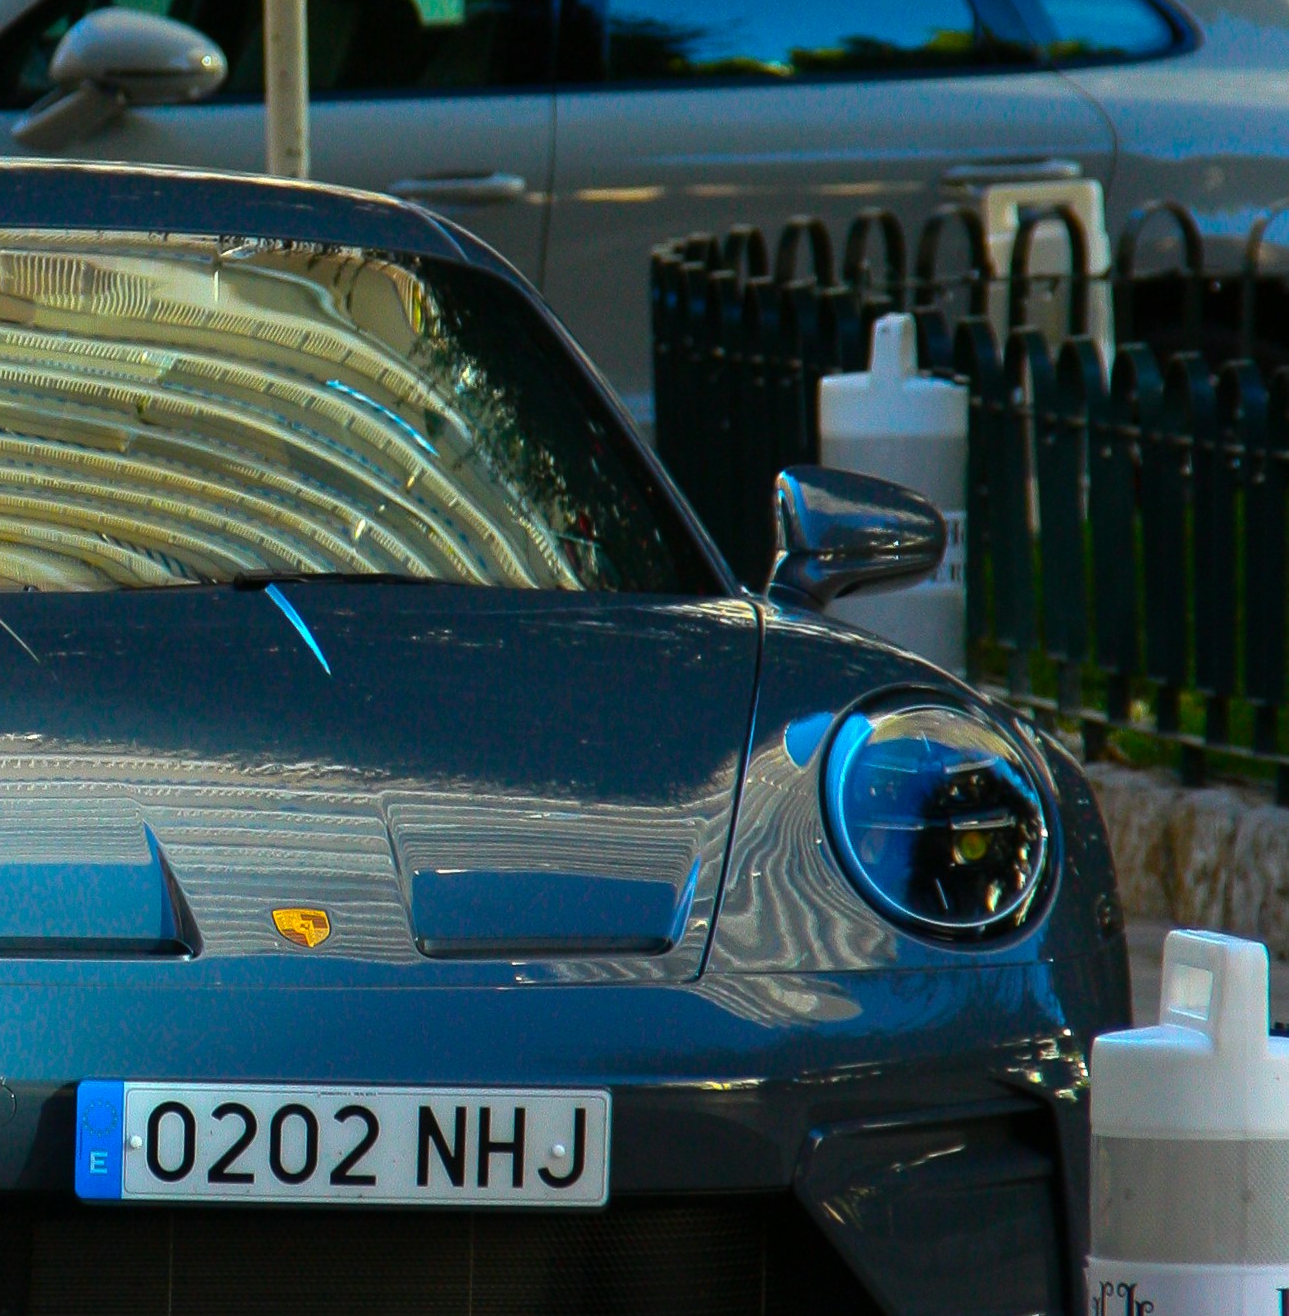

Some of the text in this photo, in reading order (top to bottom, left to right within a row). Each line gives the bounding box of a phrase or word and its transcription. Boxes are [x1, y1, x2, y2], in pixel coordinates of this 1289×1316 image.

[90, 1150, 109, 1174] E
[146, 1100, 587, 1189] 0202 NHJ
